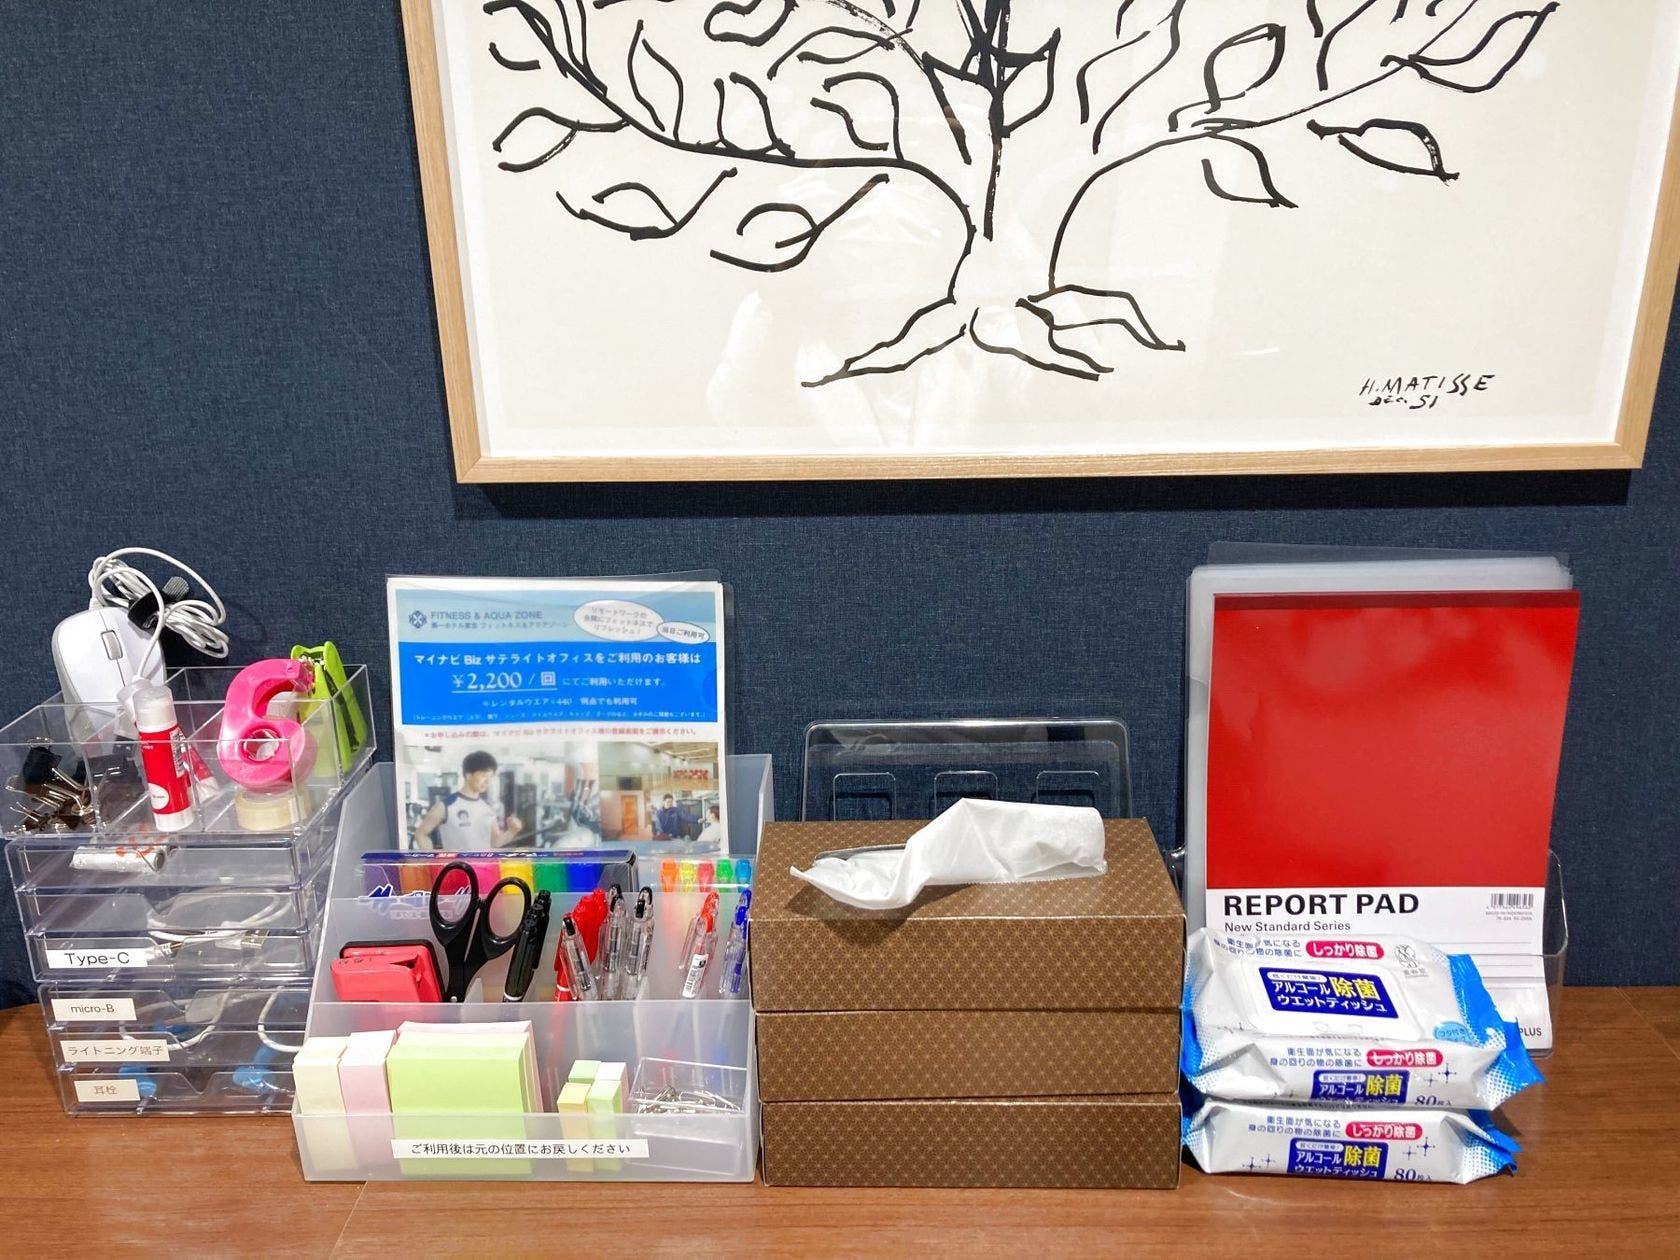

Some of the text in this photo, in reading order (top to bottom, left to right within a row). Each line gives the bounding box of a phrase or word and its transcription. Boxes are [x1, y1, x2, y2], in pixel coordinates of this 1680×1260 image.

[430, 610, 544, 621] FITNESS & AQUA ZONE
[414, 652, 701, 666] マイナビ Biz サテライトオフィスをご利用のお客様は
[540, 671, 556, 686] 回
[1224, 893, 1419, 916] REPORT PAD
[1225, 921, 1351, 932] New Standard Series
[1312, 942, 1378, 959] しっかり除菌
[64, 952, 130, 966] Type-C
[1271, 976, 1381, 1000] アルコール 除菌
[71, 1004, 115, 1014] micro-B
[1277, 995, 1388, 1012] ウエットティッシュ
[68, 1045, 162, 1056] ライトニング端子
[94, 1086, 117, 1095] 耳栓
[1320, 1074, 1403, 1096] アルコール 除菌
[1353, 1123, 1416, 1138] しっかり除菌
[411, 1143, 631, 1155] ご利用後は元の位置にお戻しください
[1296, 1145, 1382, 1167] アルコール 除菌
